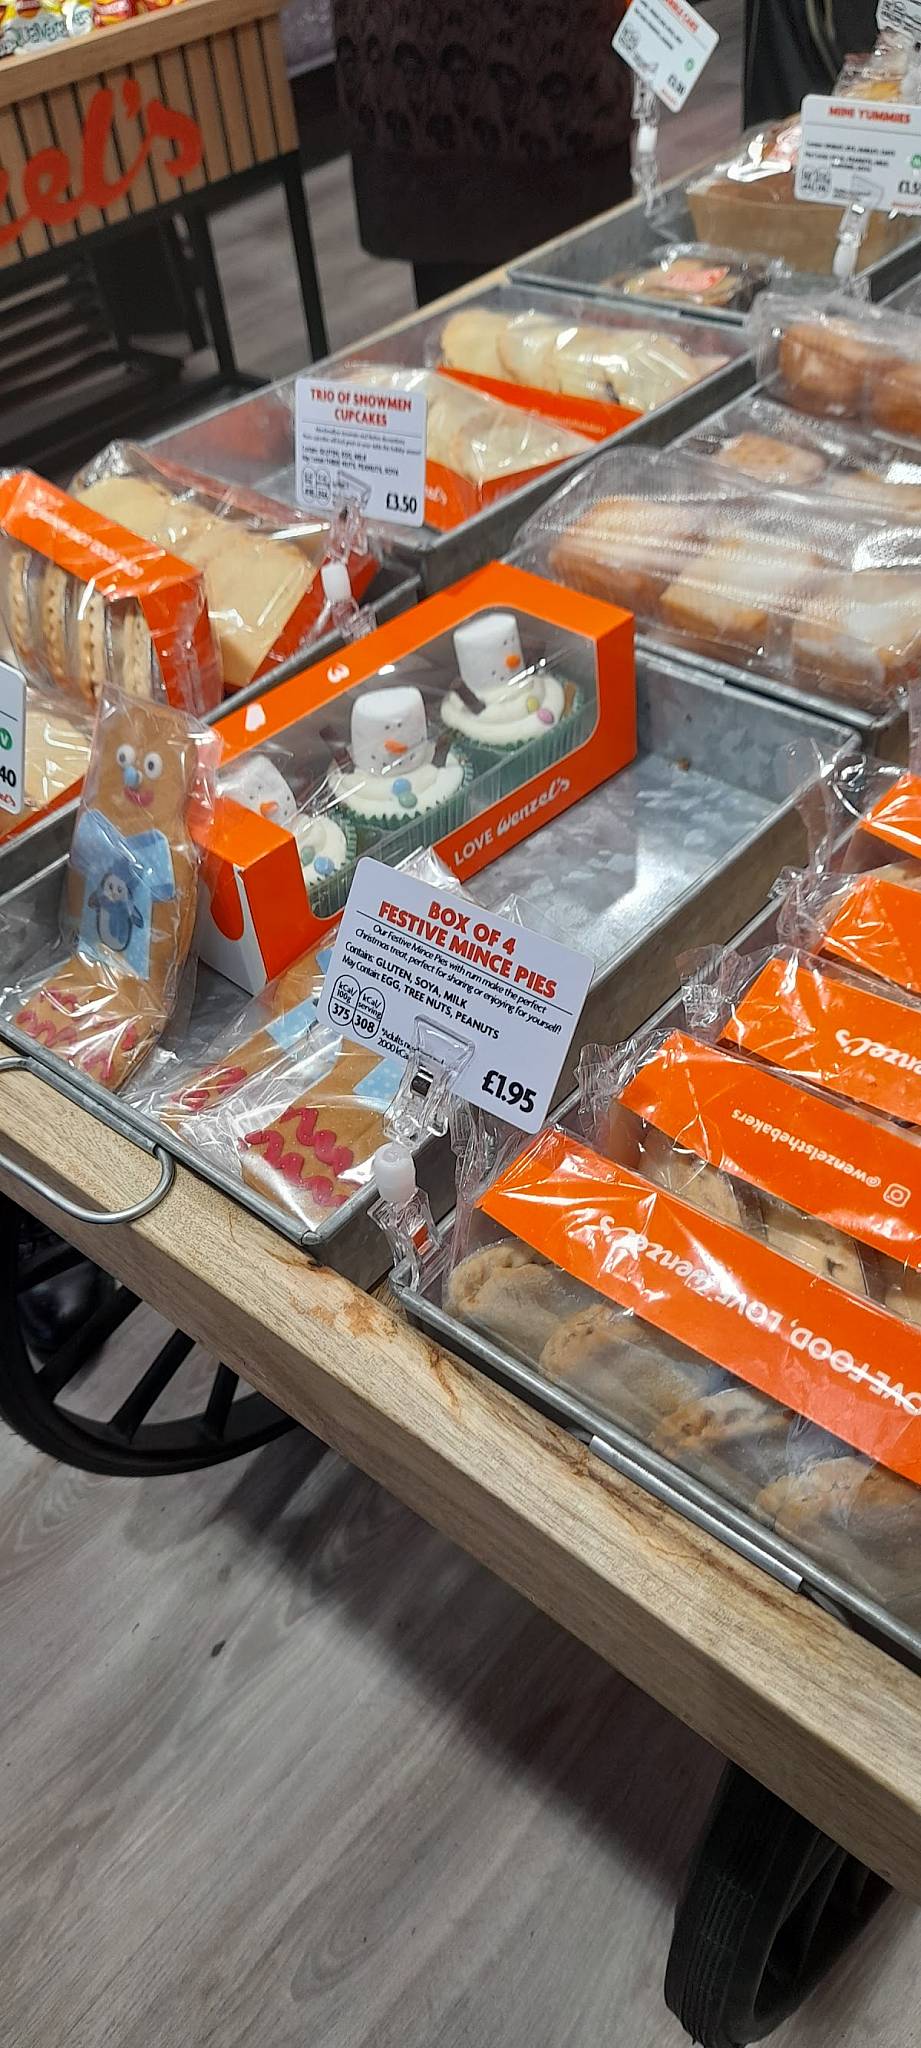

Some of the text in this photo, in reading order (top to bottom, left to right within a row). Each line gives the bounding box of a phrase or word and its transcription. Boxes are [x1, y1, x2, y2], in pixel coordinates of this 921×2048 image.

[311, 388, 412, 412] TRIO OF SNOWMEN
[334, 408, 388, 426] CUPCAKES
[386, 492, 417, 514] £3.50
[455, 829, 491, 864] LOVE
[378, 901, 557, 998] FESTIVE MINCE PIES
[428, 901, 516, 955] BOX OF 4
[345, 941, 468, 1009] Contains: GLUTEN, SOYA, MILK
[355, 928, 562, 1035] Christmas treat, perfect for sharing or enjoying for yourself!
[373, 925, 547, 1014] Our Festive Mince Pies with rum make the perfect
[332, 1003, 351, 1020] 375
[336, 989, 352, 1004] 100g
[341, 954, 356, 969] May
[380, 974, 401, 992] EGG,
[404, 985, 425, 1003] TREE
[425, 999, 453, 1019] NUTS,
[455, 1011, 500, 1040] PEANUTS
[358, 1002, 383, 1020] serving
[354, 1014, 376, 1033] 308
[481, 1069, 537, 1113] £1.95
[731, 1108, 882, 1188] @wenzelsthebakers
[789, 1317, 871, 1384] FOOD,
